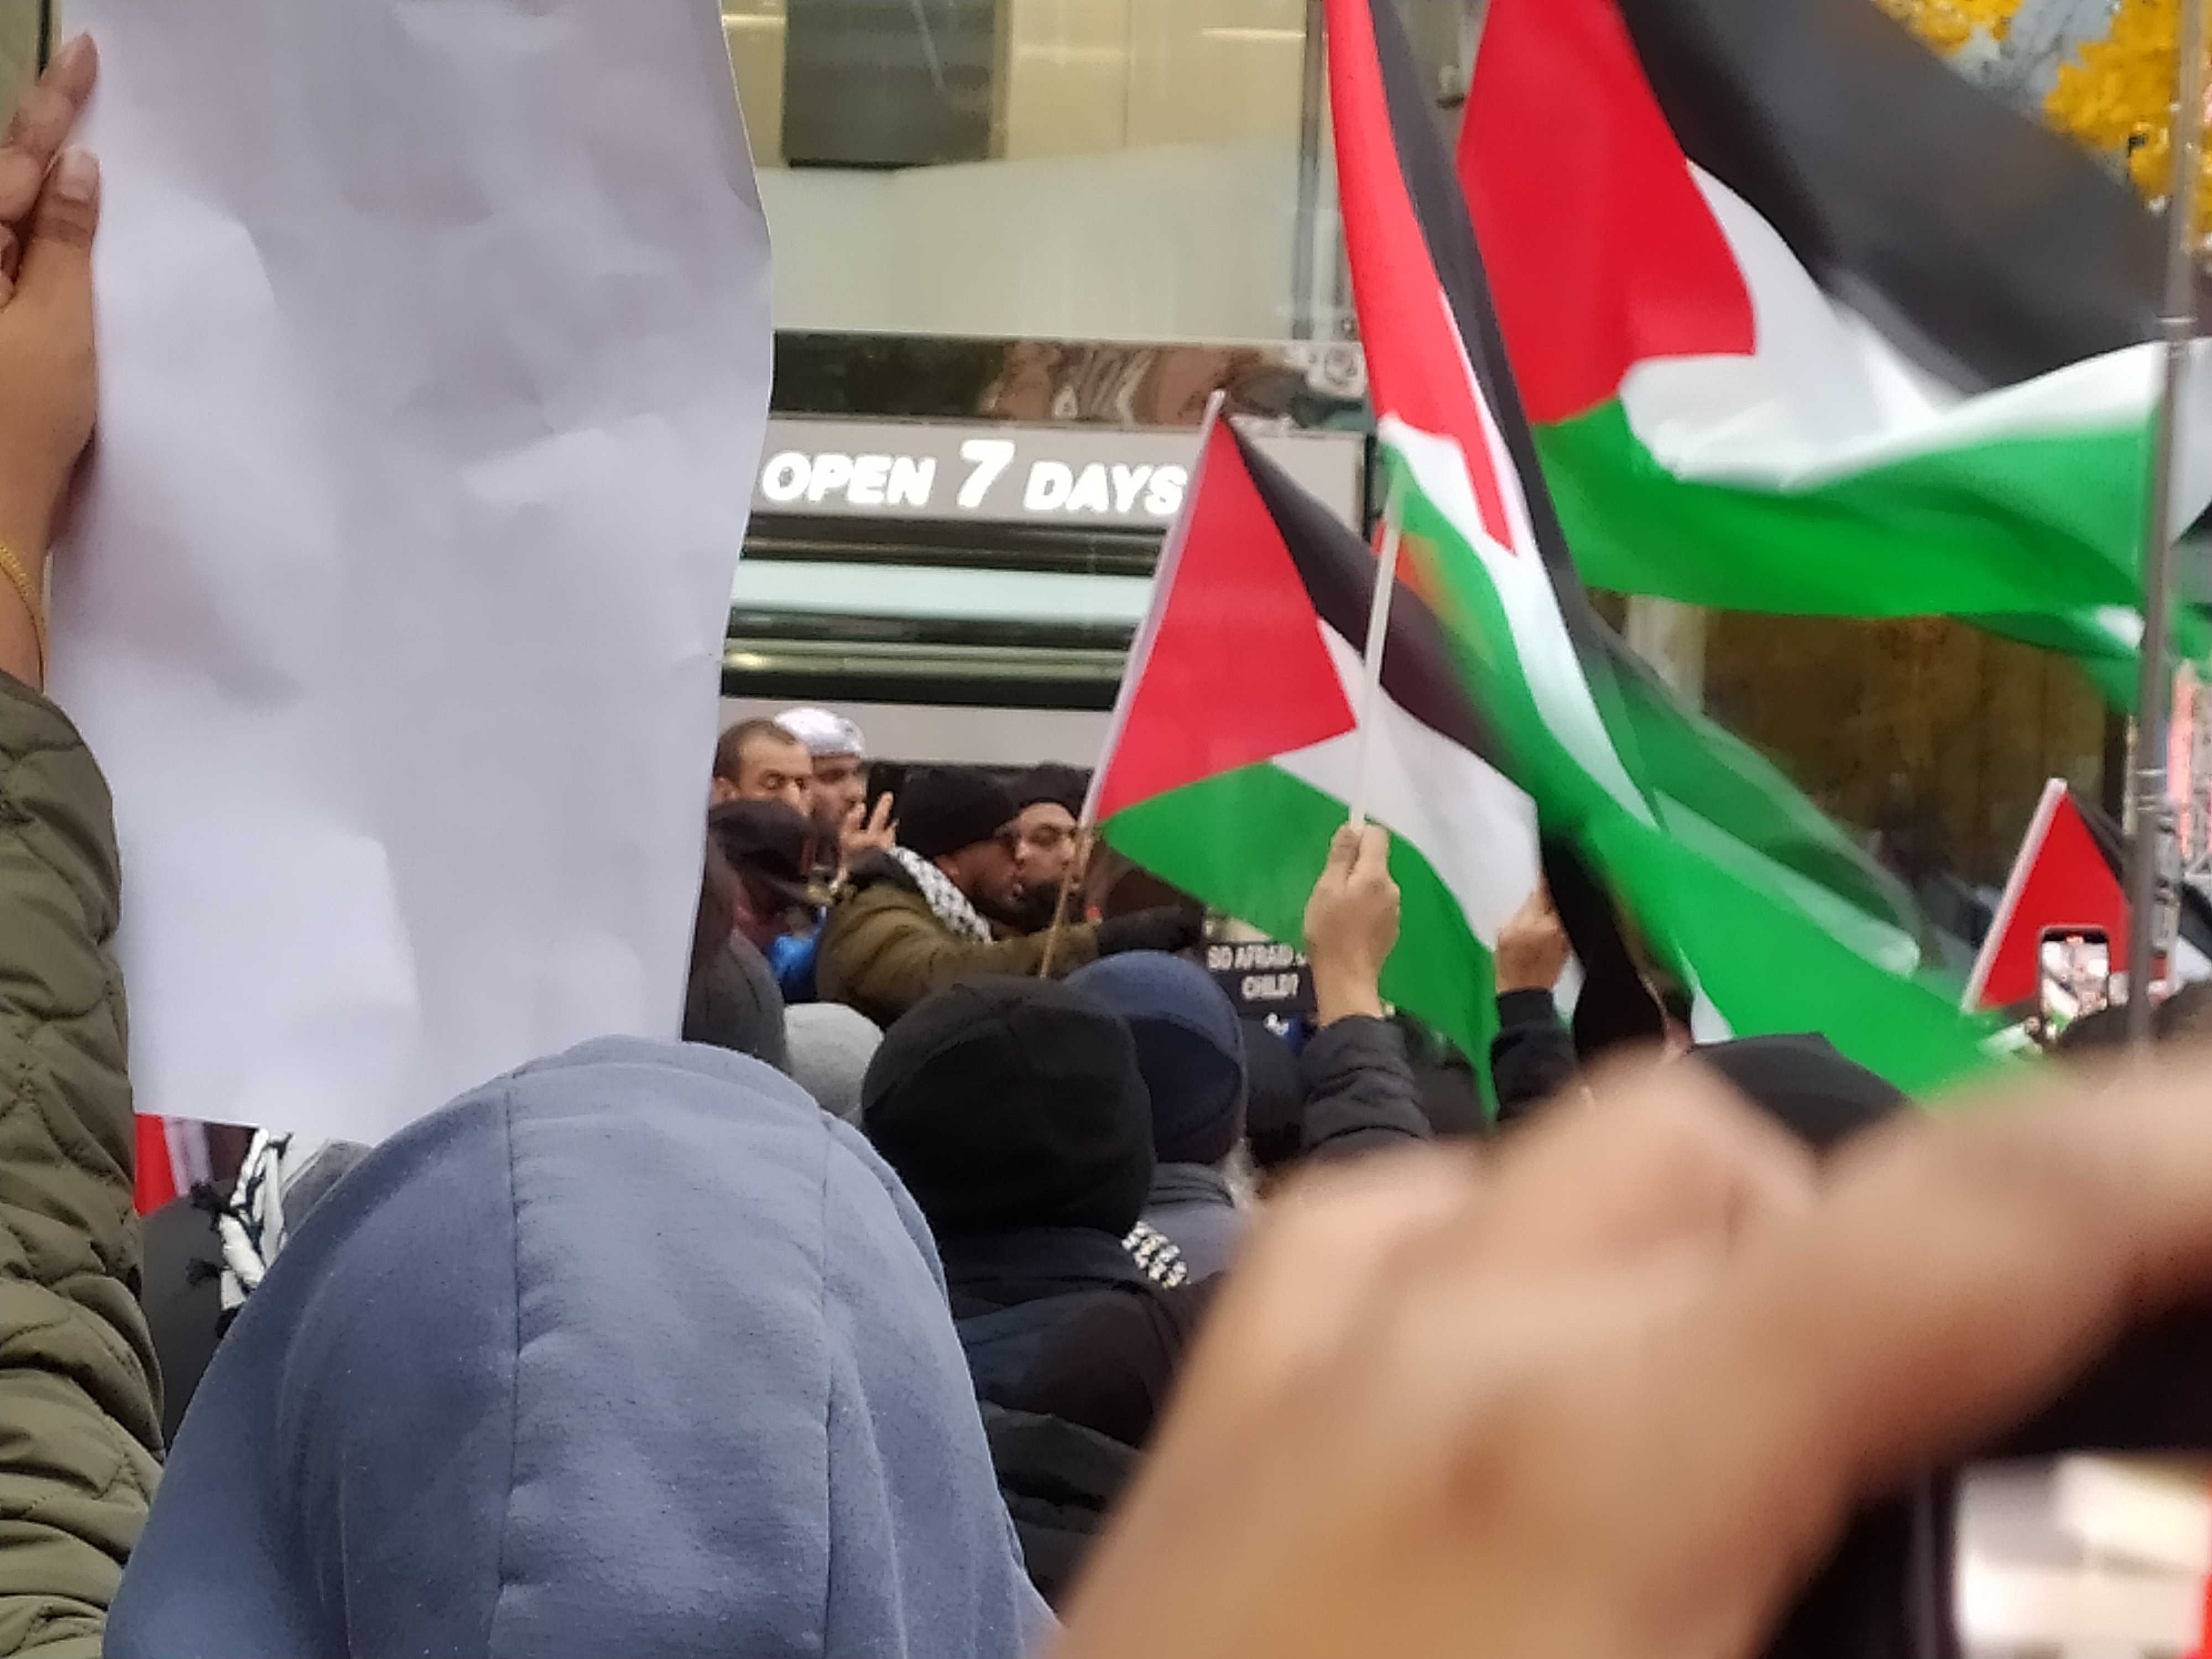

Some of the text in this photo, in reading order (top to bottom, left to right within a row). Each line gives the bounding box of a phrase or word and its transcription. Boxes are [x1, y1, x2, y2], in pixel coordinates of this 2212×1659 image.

[762, 440, 1187, 514] OPEN 7 DAYS
[1208, 945, 1233, 970] SO
